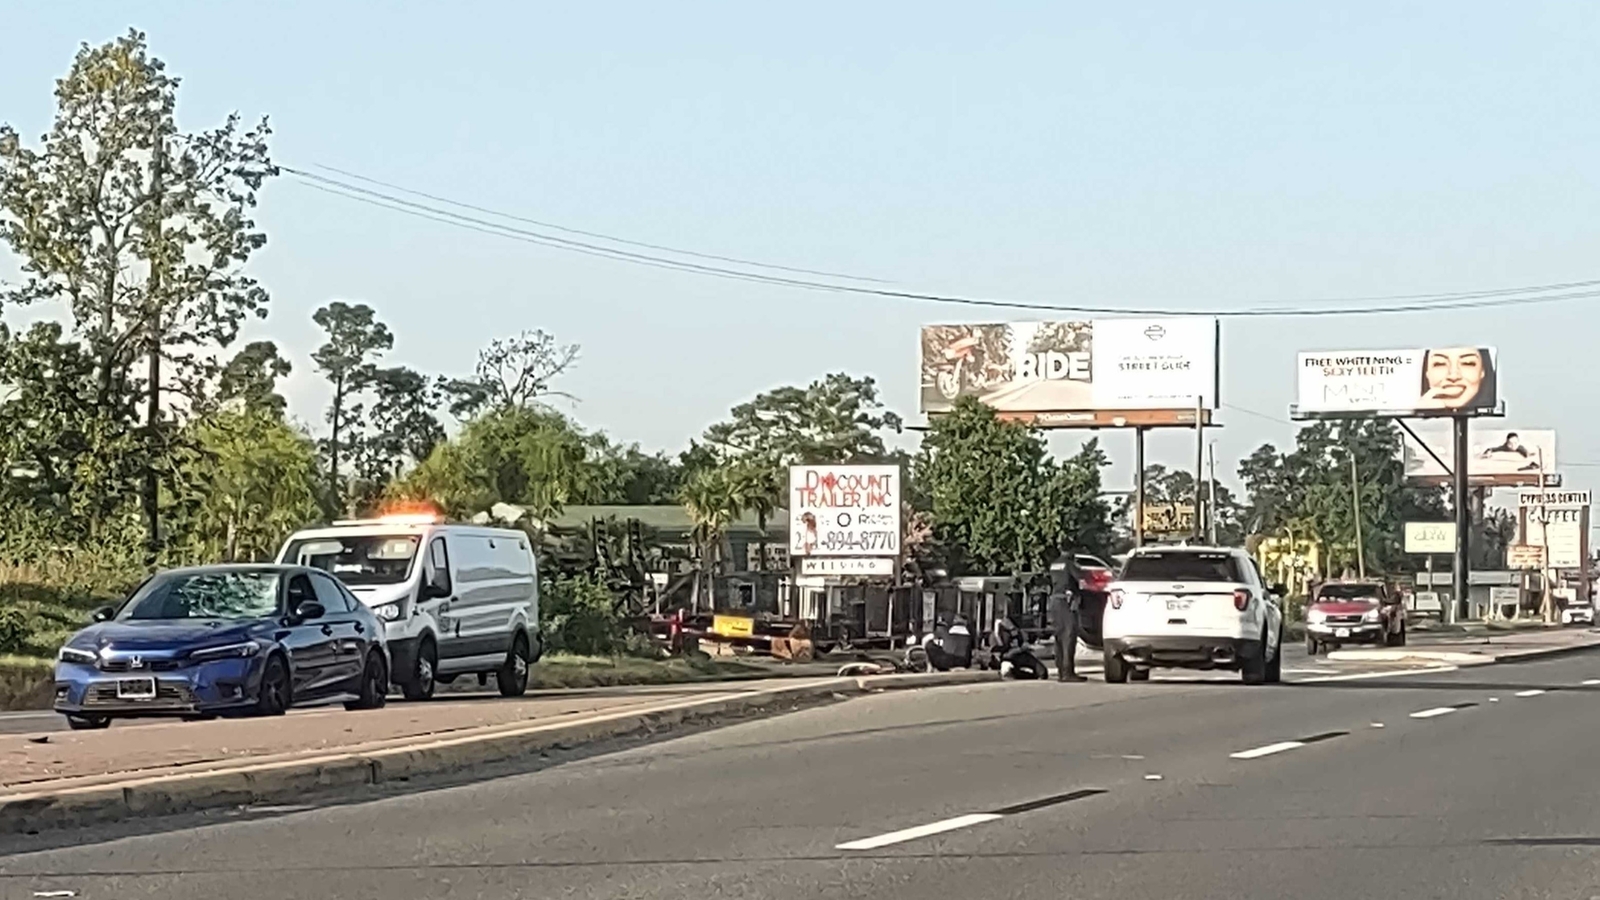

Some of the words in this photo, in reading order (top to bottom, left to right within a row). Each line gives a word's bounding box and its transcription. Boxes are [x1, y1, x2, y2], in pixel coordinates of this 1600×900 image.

[1014, 351, 1093, 383] RIDE
[806, 470, 892, 493] DICOUNT
[1521, 493, 1557, 504] CYPRSS
[1529, 509, 1578, 523] CFFEE
